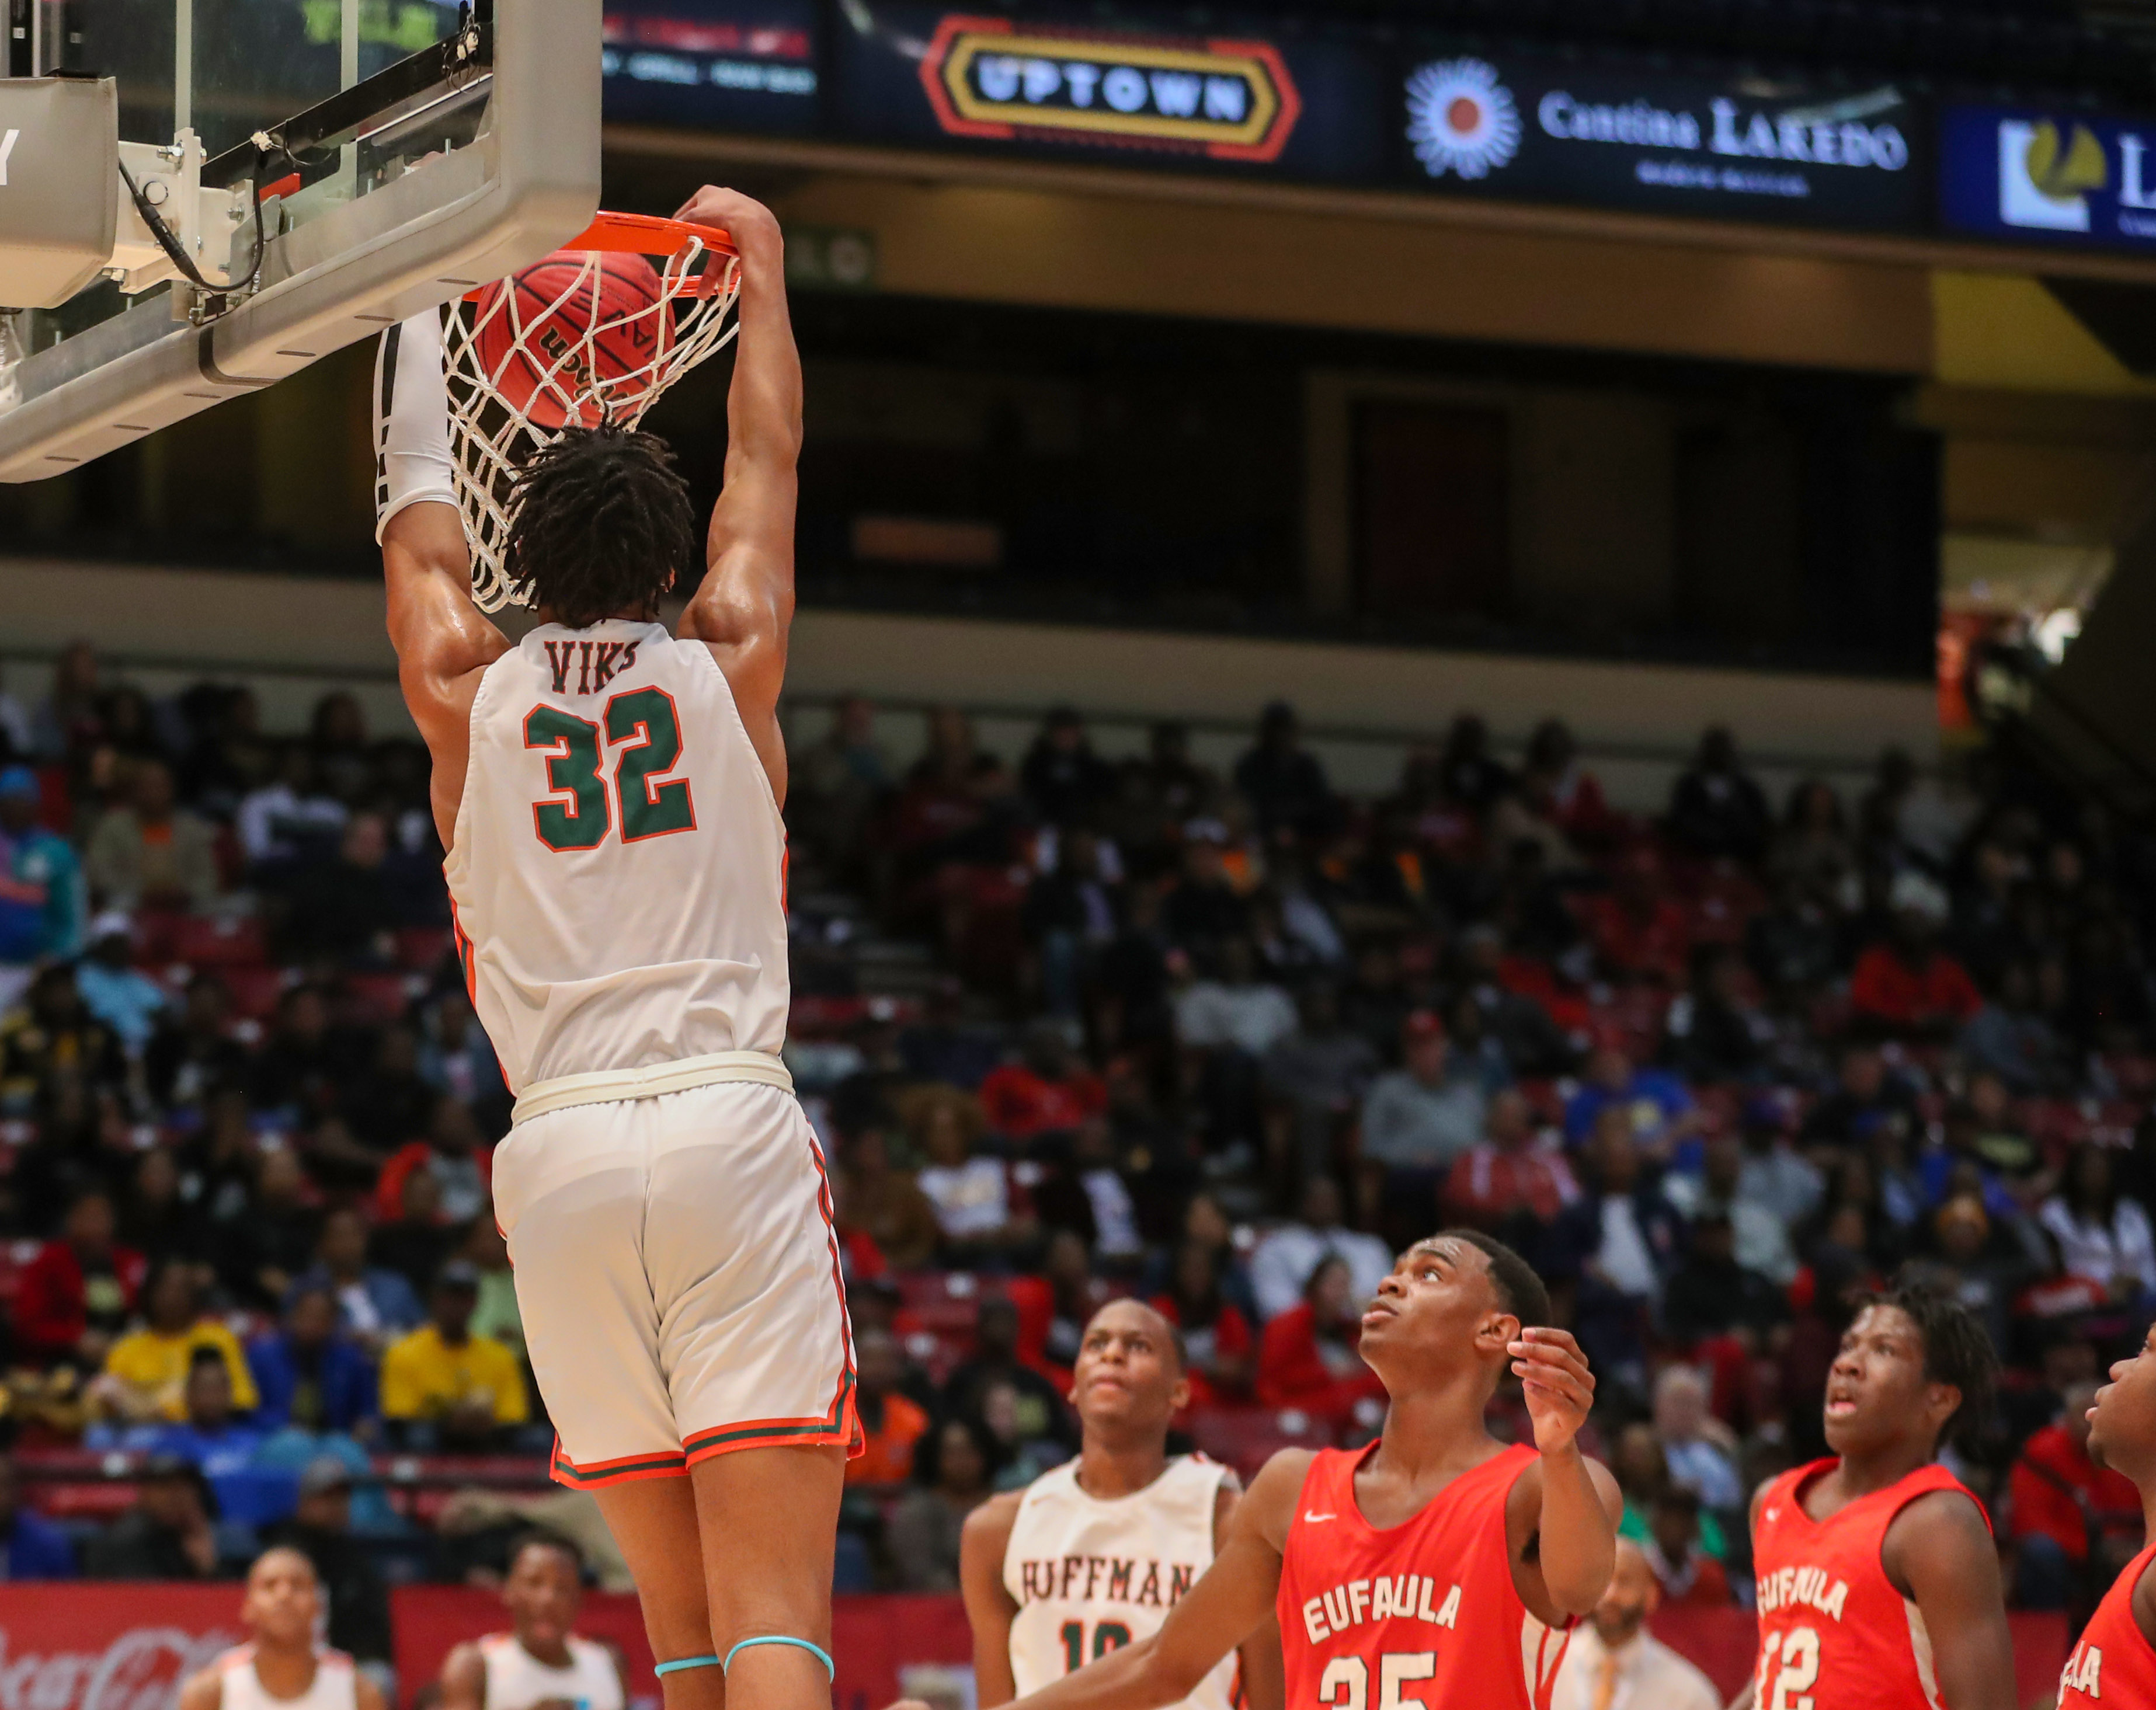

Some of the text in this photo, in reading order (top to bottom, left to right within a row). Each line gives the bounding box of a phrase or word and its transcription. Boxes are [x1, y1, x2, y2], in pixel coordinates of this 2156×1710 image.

[976, 55, 1246, 121] UPTOWN
[523, 685, 697, 853] 32
[1023, 1555, 1194, 1607] HUFFMAN
[1302, 1573, 1462, 1645] EUFAULA
